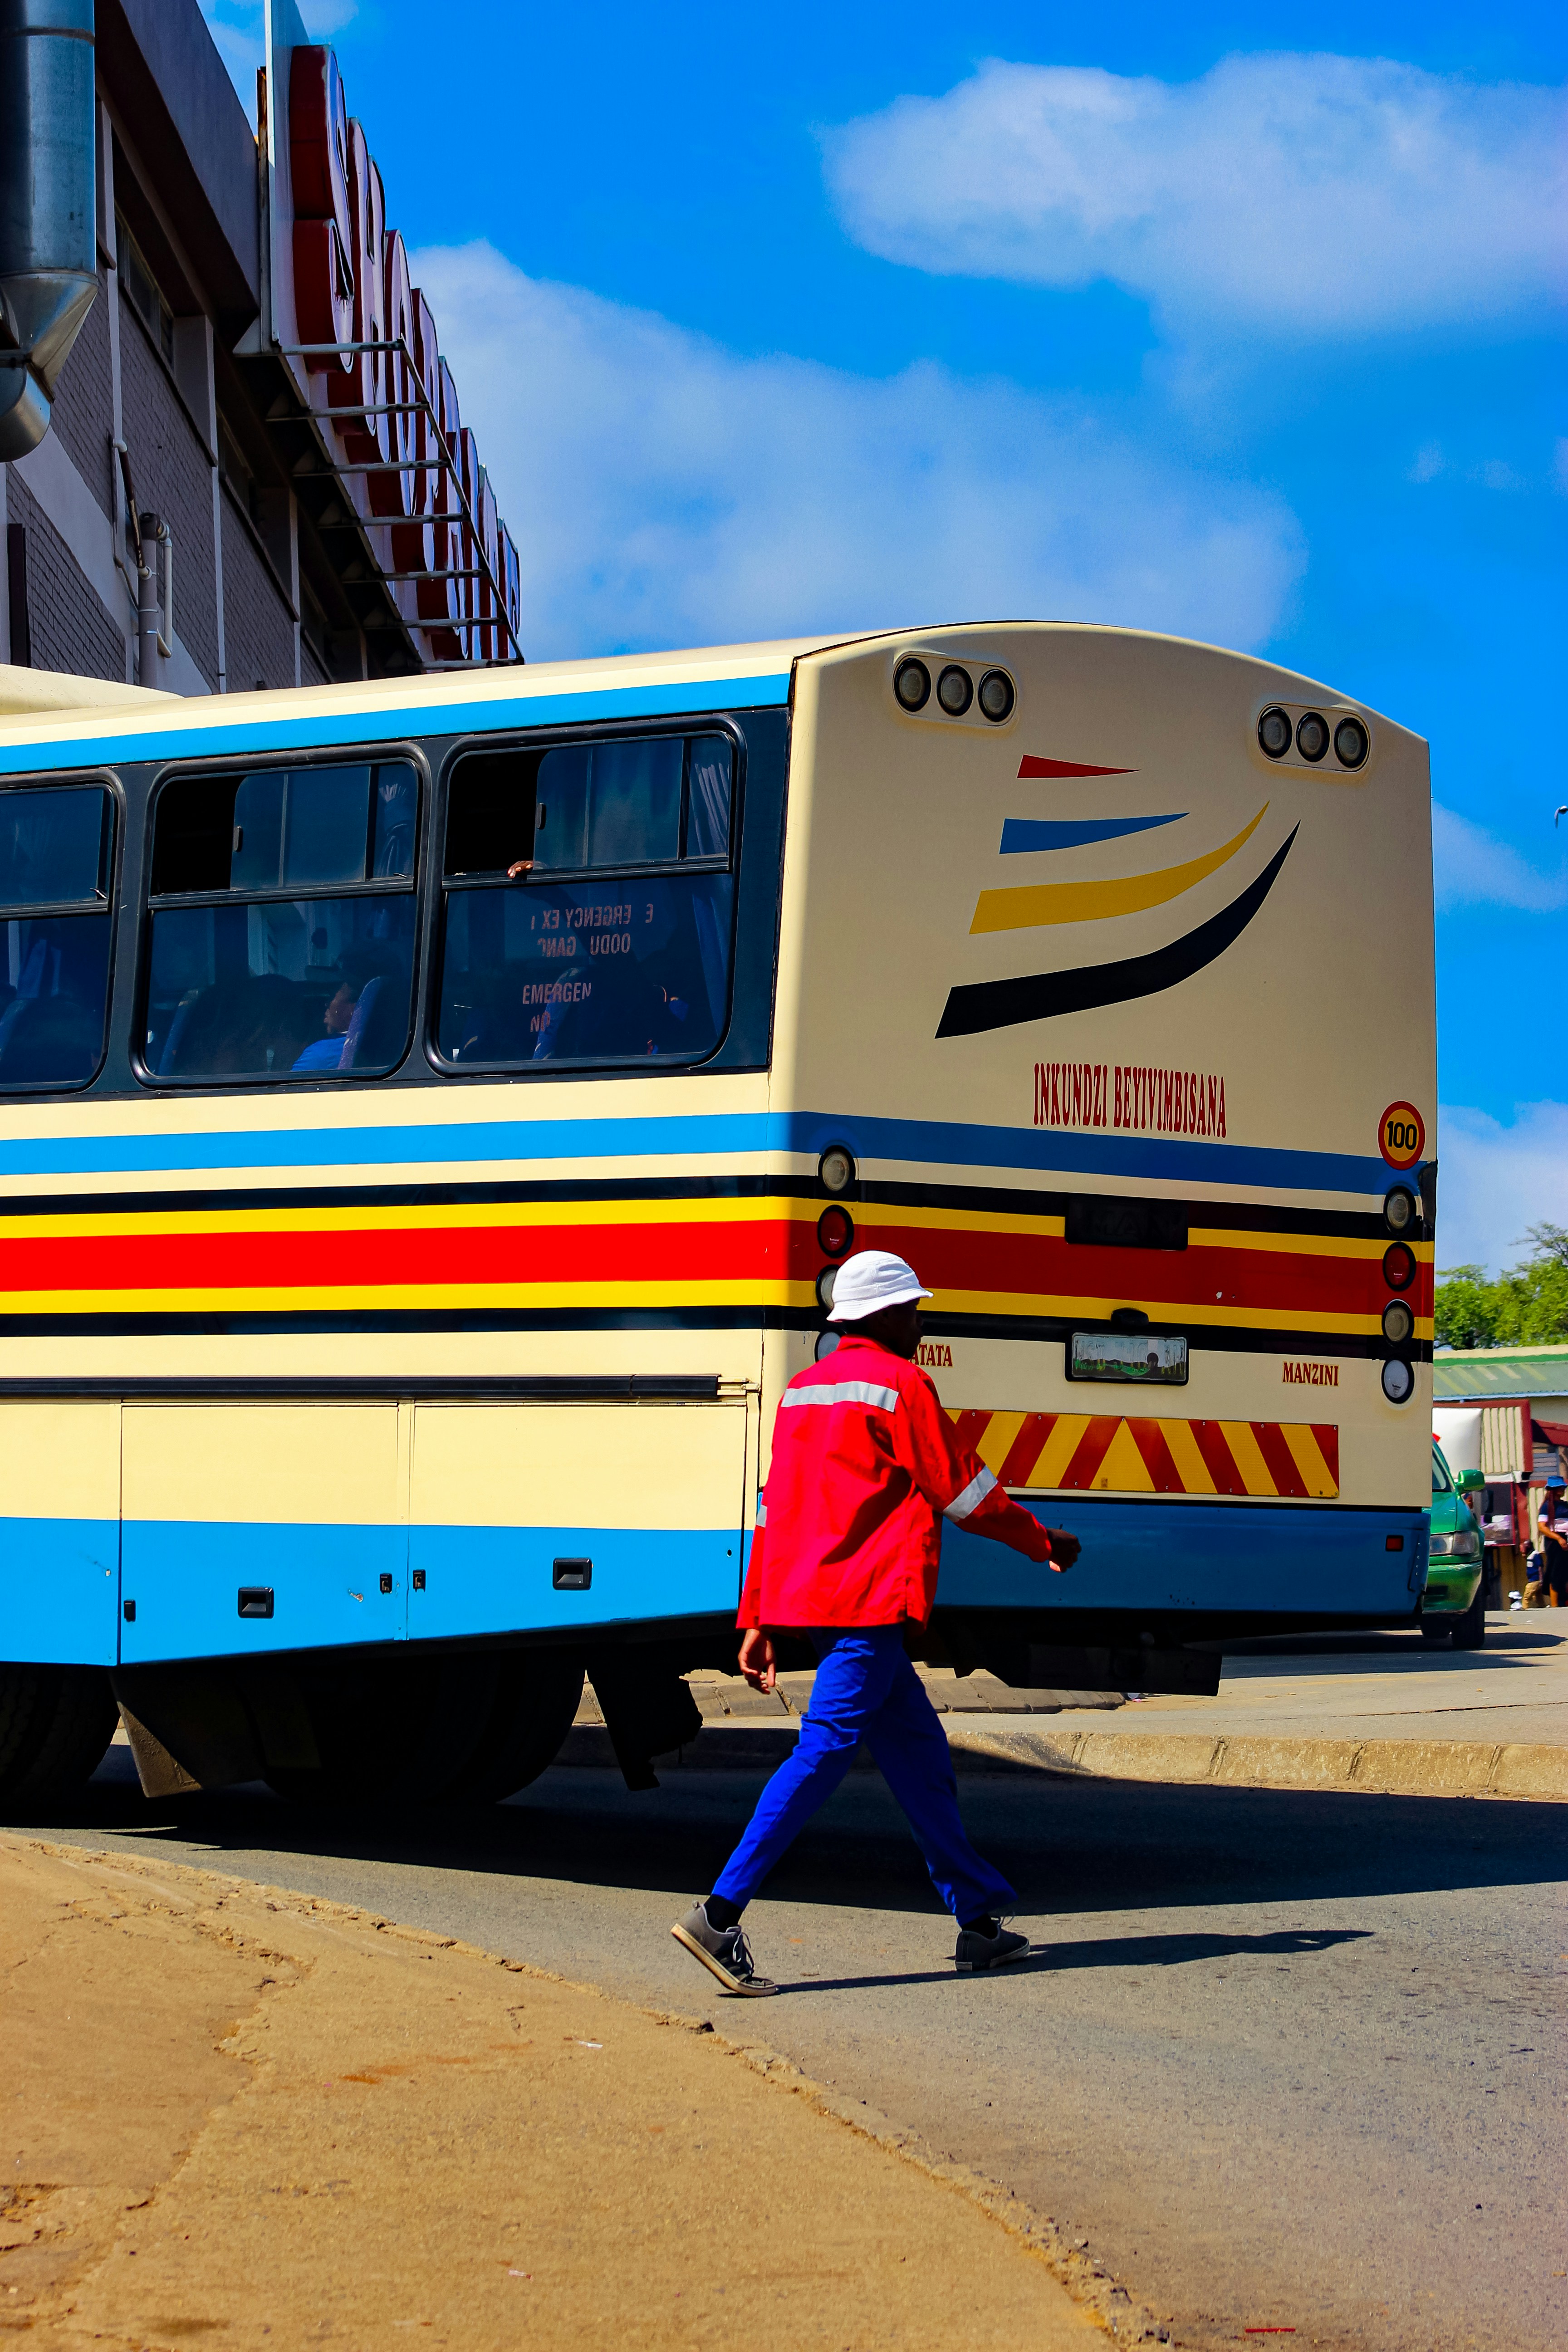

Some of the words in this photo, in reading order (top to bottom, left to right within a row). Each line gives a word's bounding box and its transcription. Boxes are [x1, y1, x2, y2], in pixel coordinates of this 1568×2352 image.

[1033, 1063, 1108, 1127] INKUNDZI
[1387, 1121, 1417, 1151] 100
[1282, 1362, 1339, 1386] MANZINI
